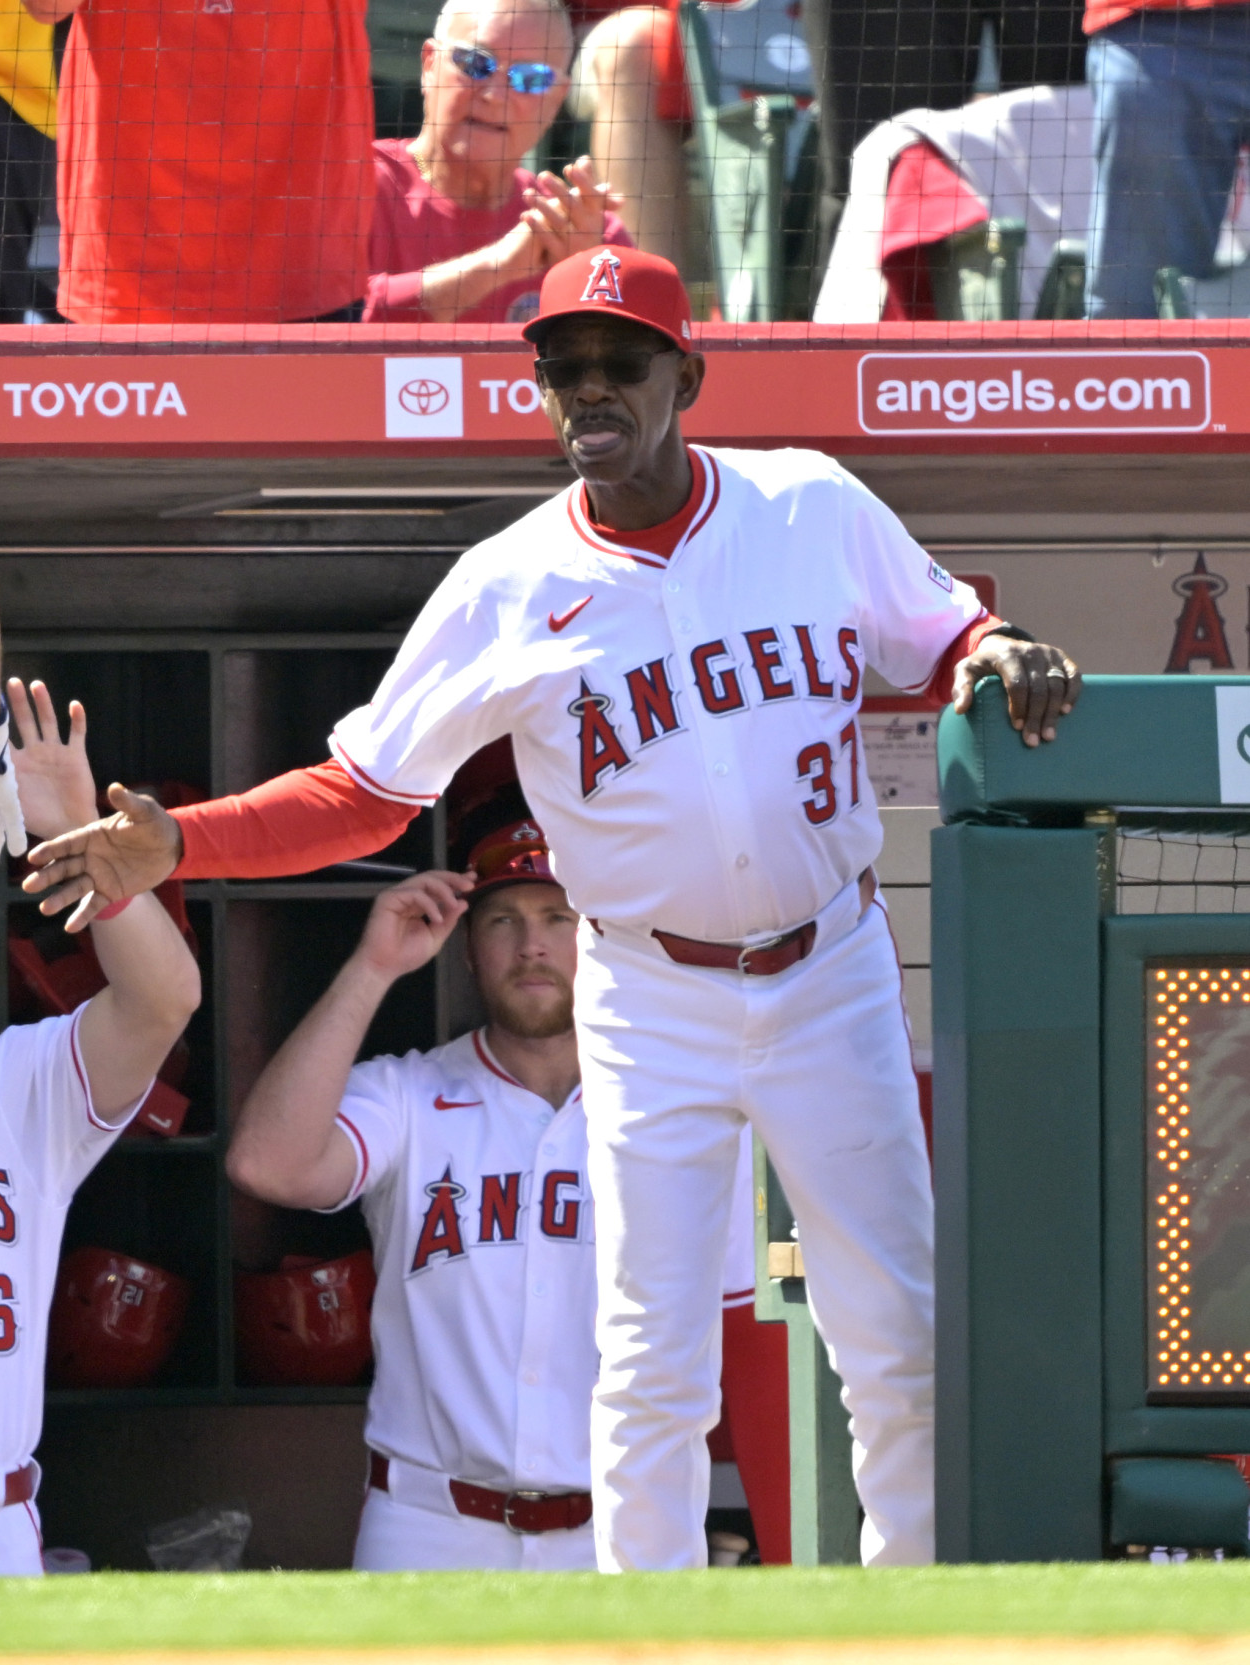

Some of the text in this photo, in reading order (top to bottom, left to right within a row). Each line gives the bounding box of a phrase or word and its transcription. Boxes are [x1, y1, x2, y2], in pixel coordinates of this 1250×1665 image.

[3, 382, 187, 417] TOYOTA
[876, 370, 1191, 423] angels.com
[1213, 423, 1227, 432] TM
[567, 624, 862, 802] ANGELS
[796, 719, 862, 828] 37
